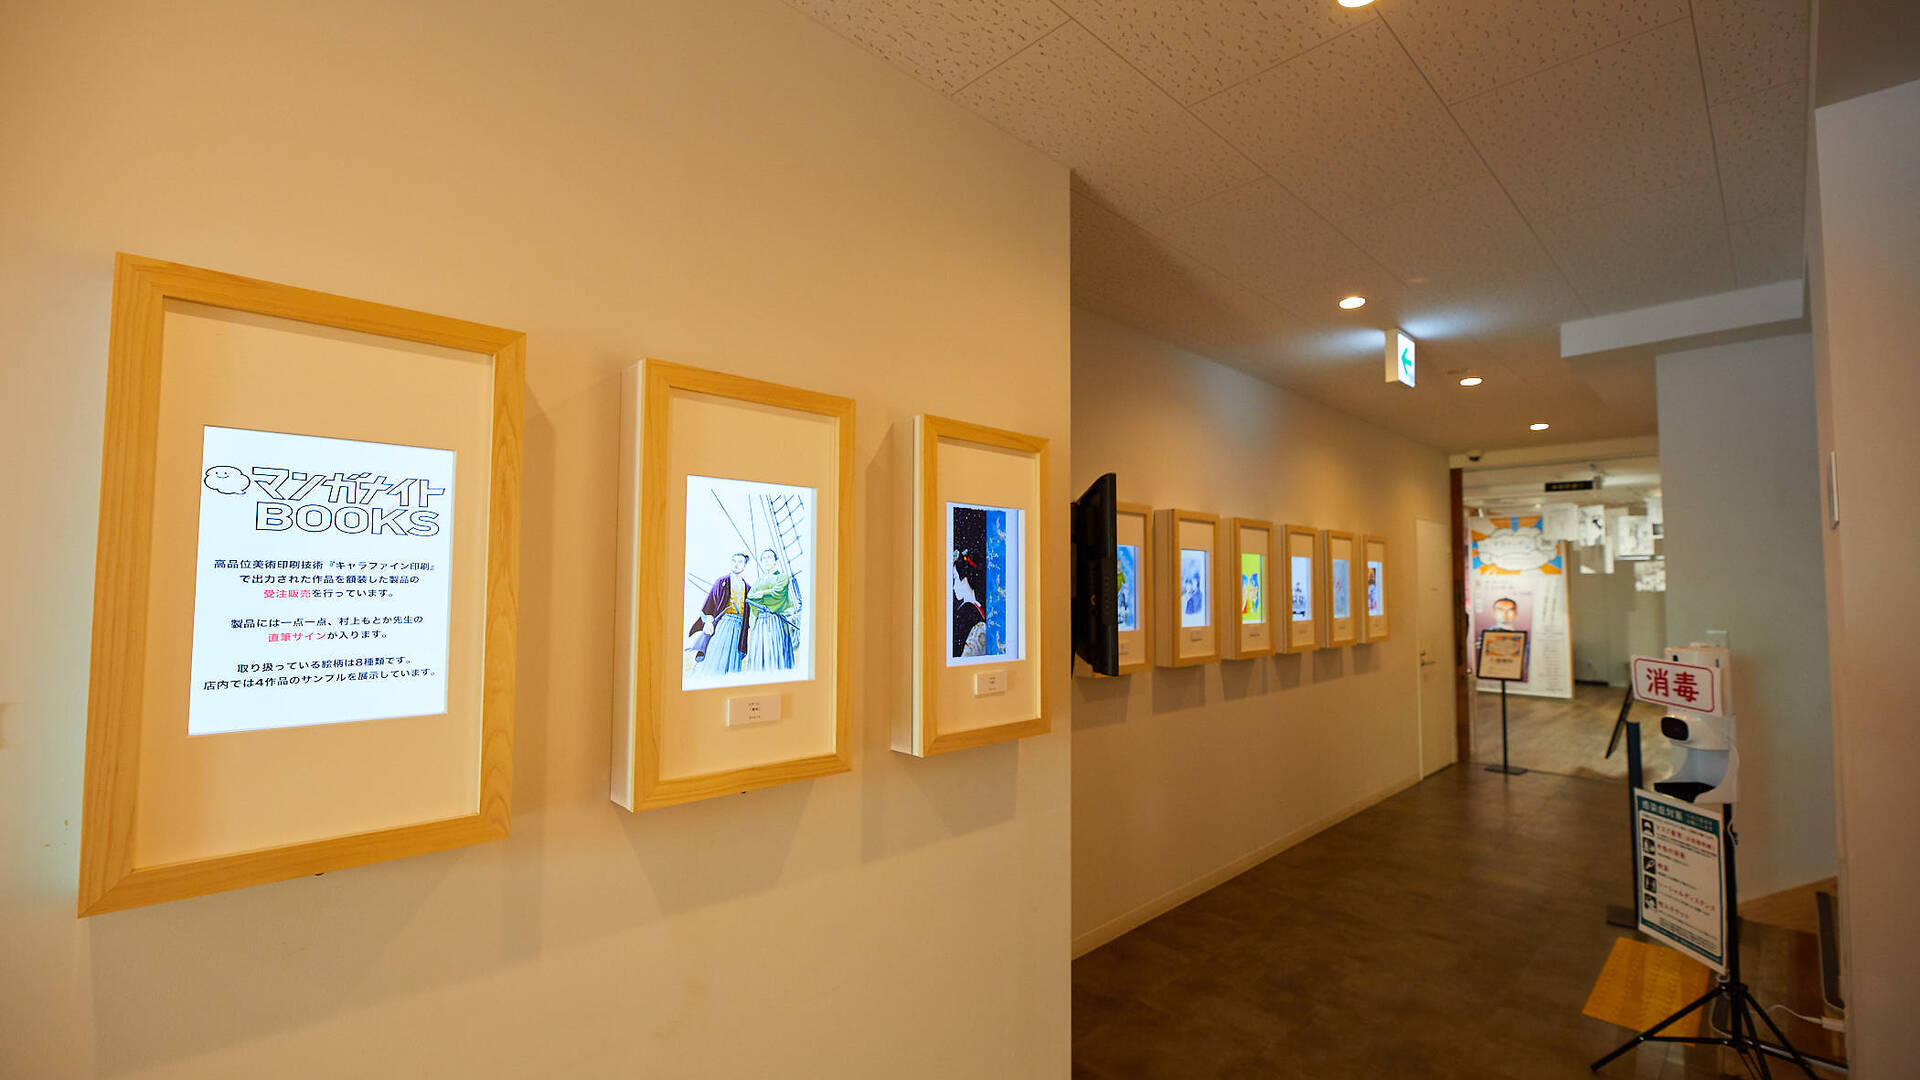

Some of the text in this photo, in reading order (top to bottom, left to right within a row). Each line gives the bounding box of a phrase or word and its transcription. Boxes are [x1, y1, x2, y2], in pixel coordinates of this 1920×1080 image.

[252, 466, 446, 508] マンガナイト
[255, 501, 440, 537] BOOKS
[239, 574, 420, 584] で出力された作品を額装した製品の
[1645, 667, 1700, 703] 消毒
